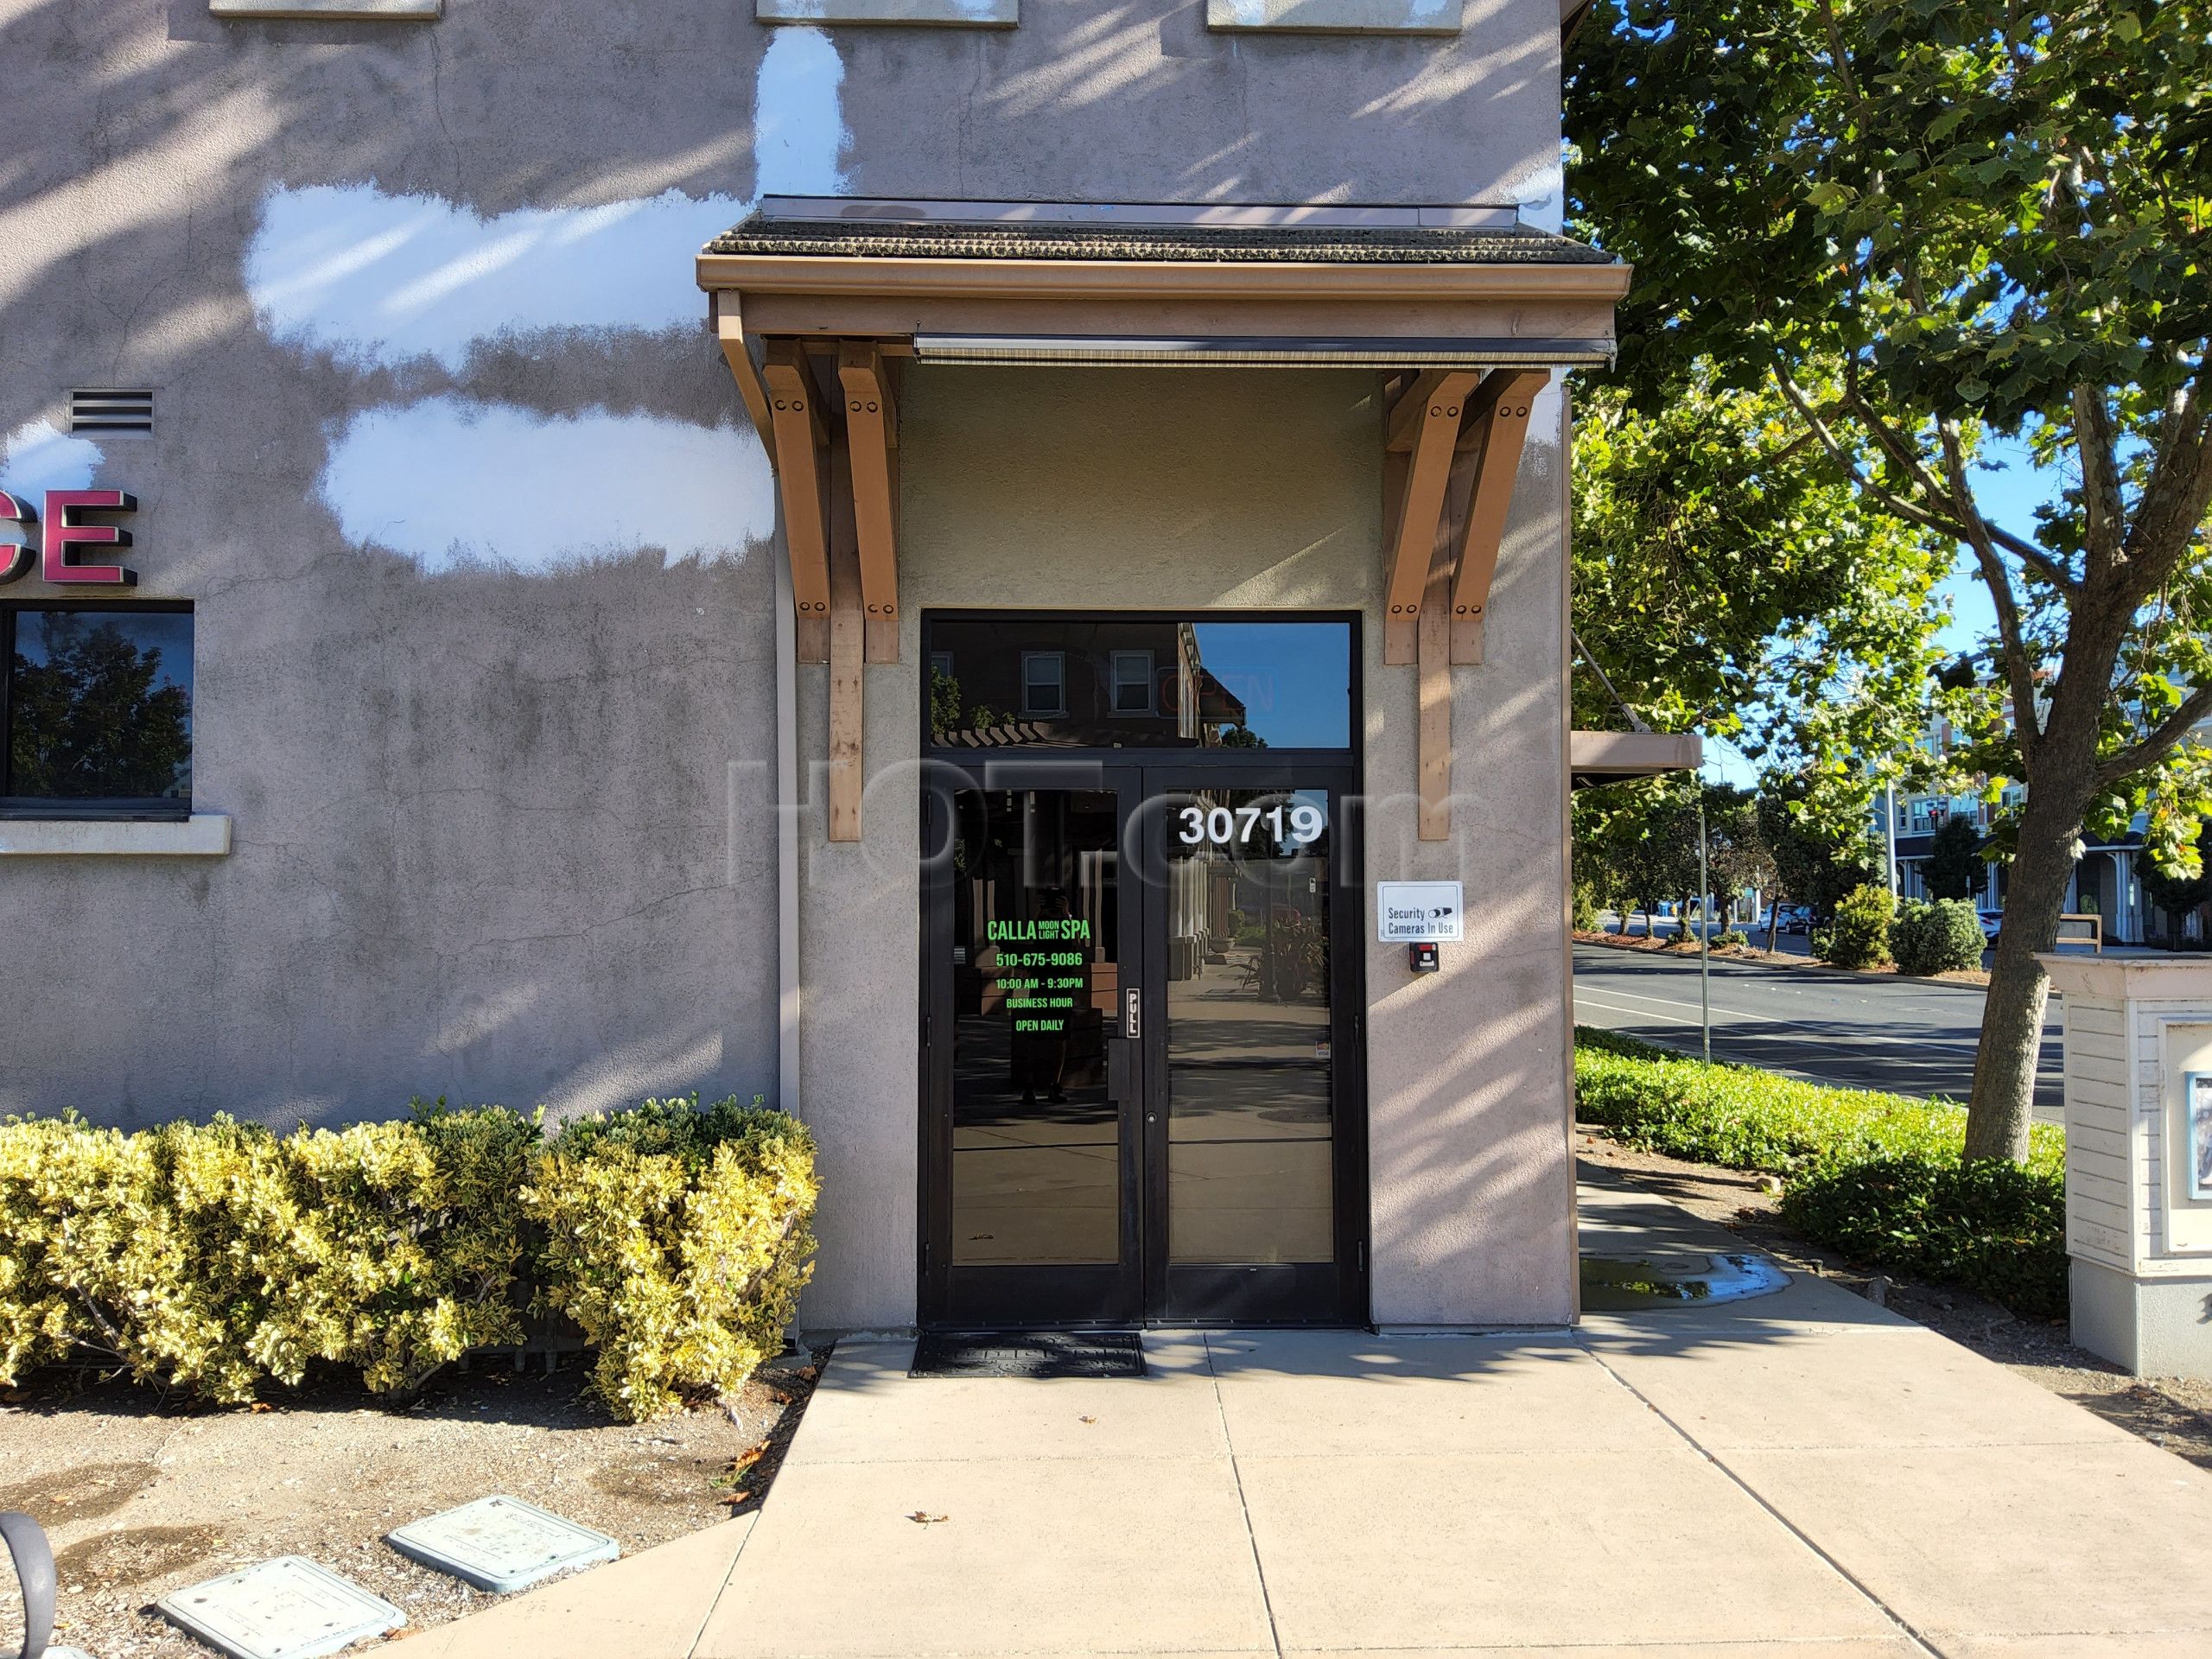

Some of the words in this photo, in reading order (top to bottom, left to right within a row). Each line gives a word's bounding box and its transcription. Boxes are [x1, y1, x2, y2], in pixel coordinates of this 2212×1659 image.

[0, 489, 137, 586] E
[1179, 805, 1323, 844] 30719
[1388, 907, 1425, 921] Security
[987, 920, 1037, 940] CALLA
[1038, 921, 1059, 930] MOON
[1061, 919, 1091, 940] SPA
[1389, 923, 1425, 934] Cameras
[1427, 922, 1436, 934] In
[1438, 922, 1453, 934] Use
[1039, 930, 1059, 940] LIGHT
[995, 953, 1083, 966] 510-675-9086
[995, 979, 1021, 989] 10:00
[1024, 979, 1039, 988] AM
[1047, 978, 1084, 988] 9:30PM
[1006, 998, 1047, 1008] BUSINESS
[1050, 998, 1073, 1007] HOUR
[1015, 1020, 1038, 1031] OPEN
[1040, 1020, 1065, 1031] DAILY
